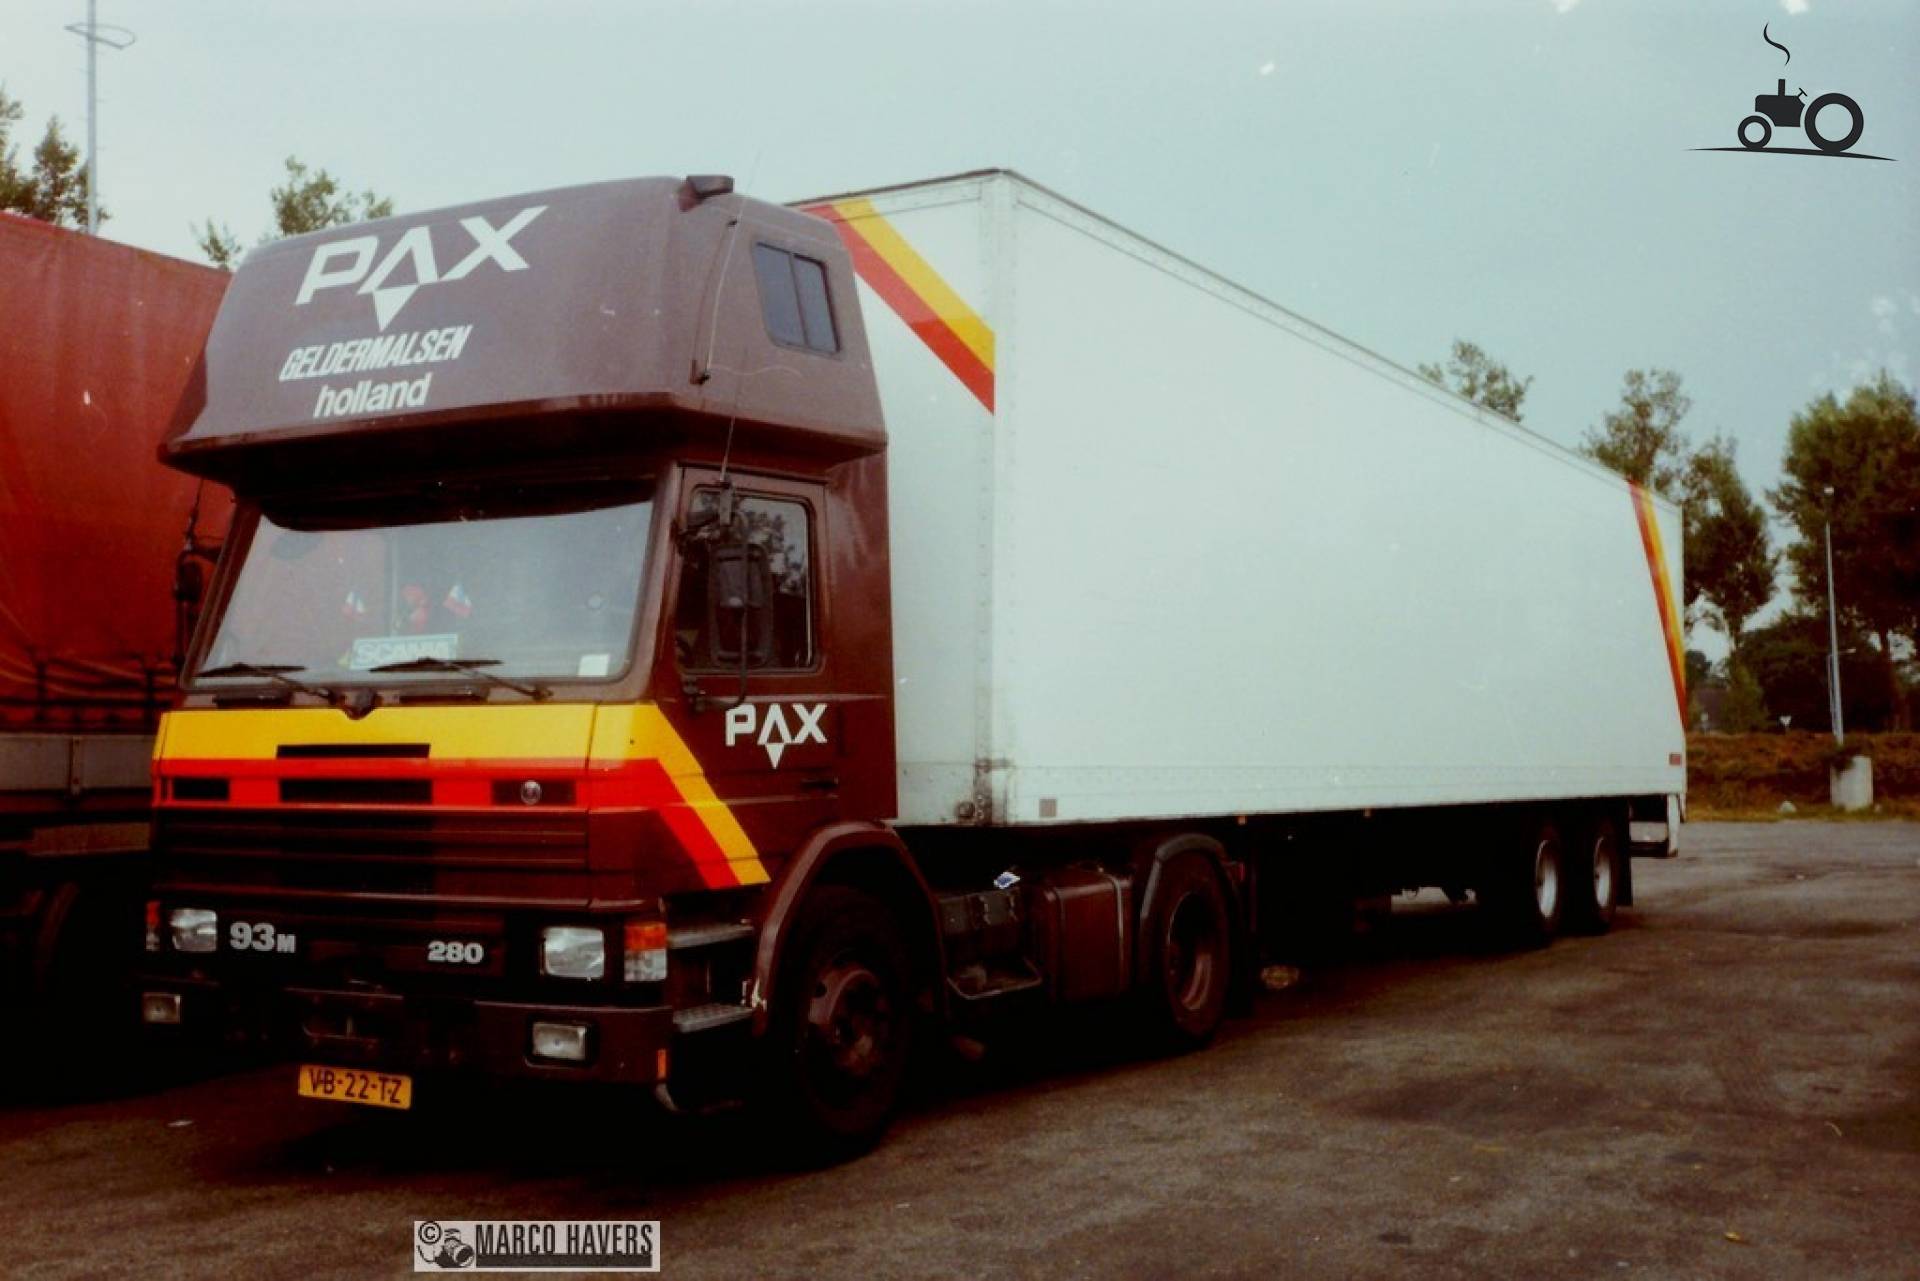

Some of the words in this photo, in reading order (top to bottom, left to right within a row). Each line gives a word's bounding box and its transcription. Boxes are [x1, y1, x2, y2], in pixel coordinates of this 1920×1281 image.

[295, 205, 550, 332] PAX
[279, 324, 474, 382] GELDERMALSEN
[312, 371, 433, 418] holland
[725, 702, 829, 769] PAX
[427, 940, 484, 964] 280
[308, 1067, 402, 1104] VB-22-TZ
